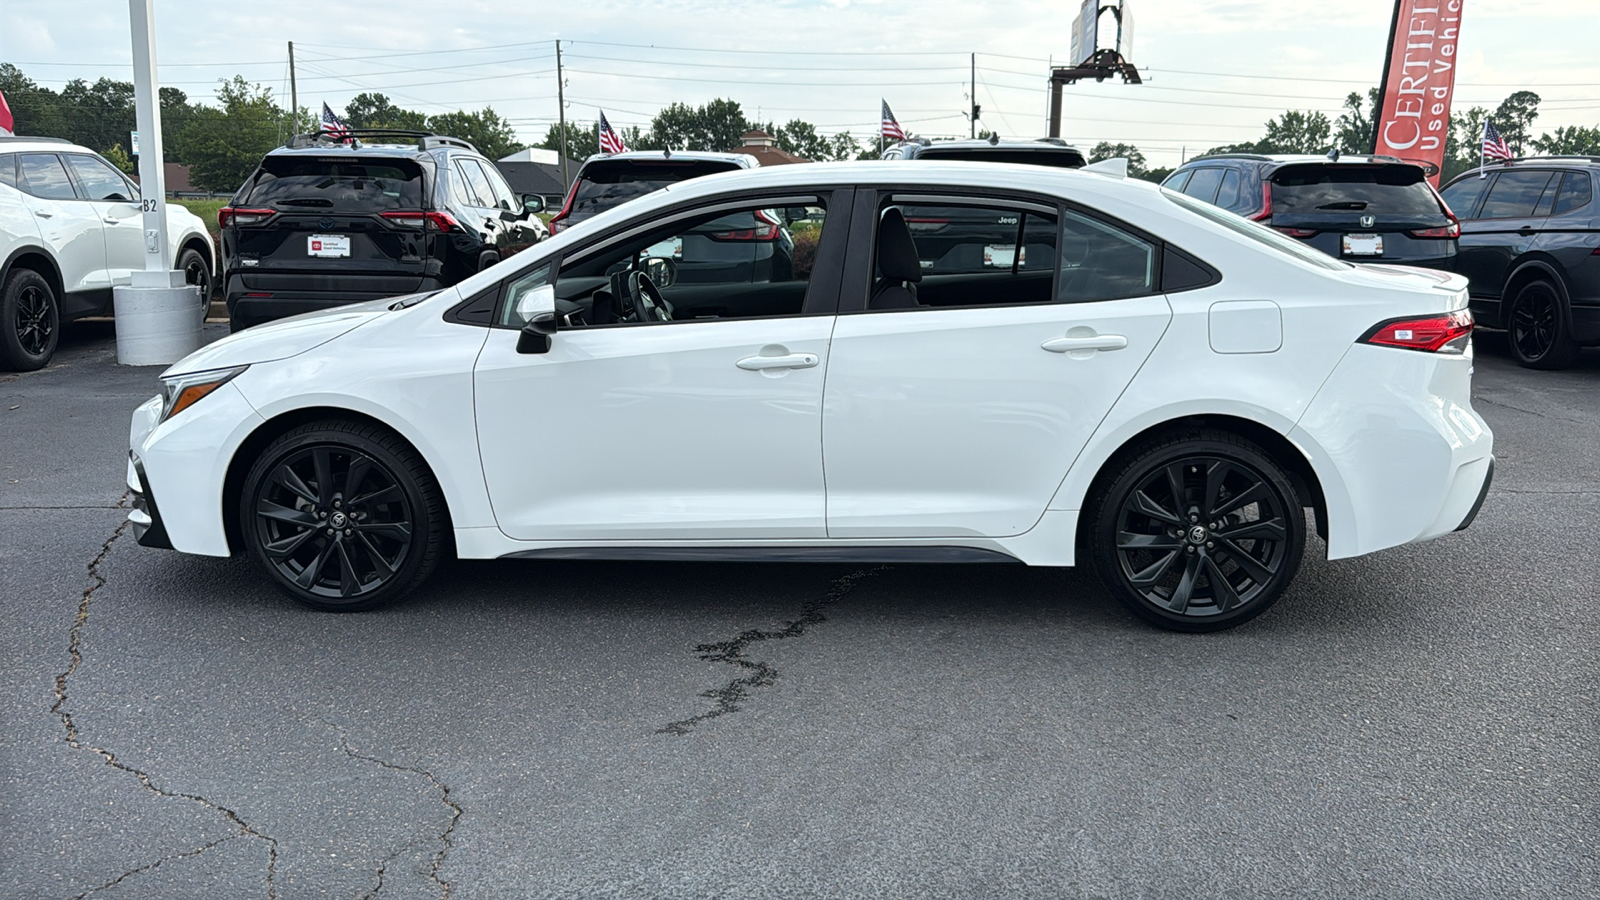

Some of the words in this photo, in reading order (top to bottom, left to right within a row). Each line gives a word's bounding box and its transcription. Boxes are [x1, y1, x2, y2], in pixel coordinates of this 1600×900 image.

[1384, 0, 1439, 150] CERTIFI
[1420, 86, 1448, 150] Used
[143, 199, 157, 212] B2
[998, 216, 1018, 225] Jeep
